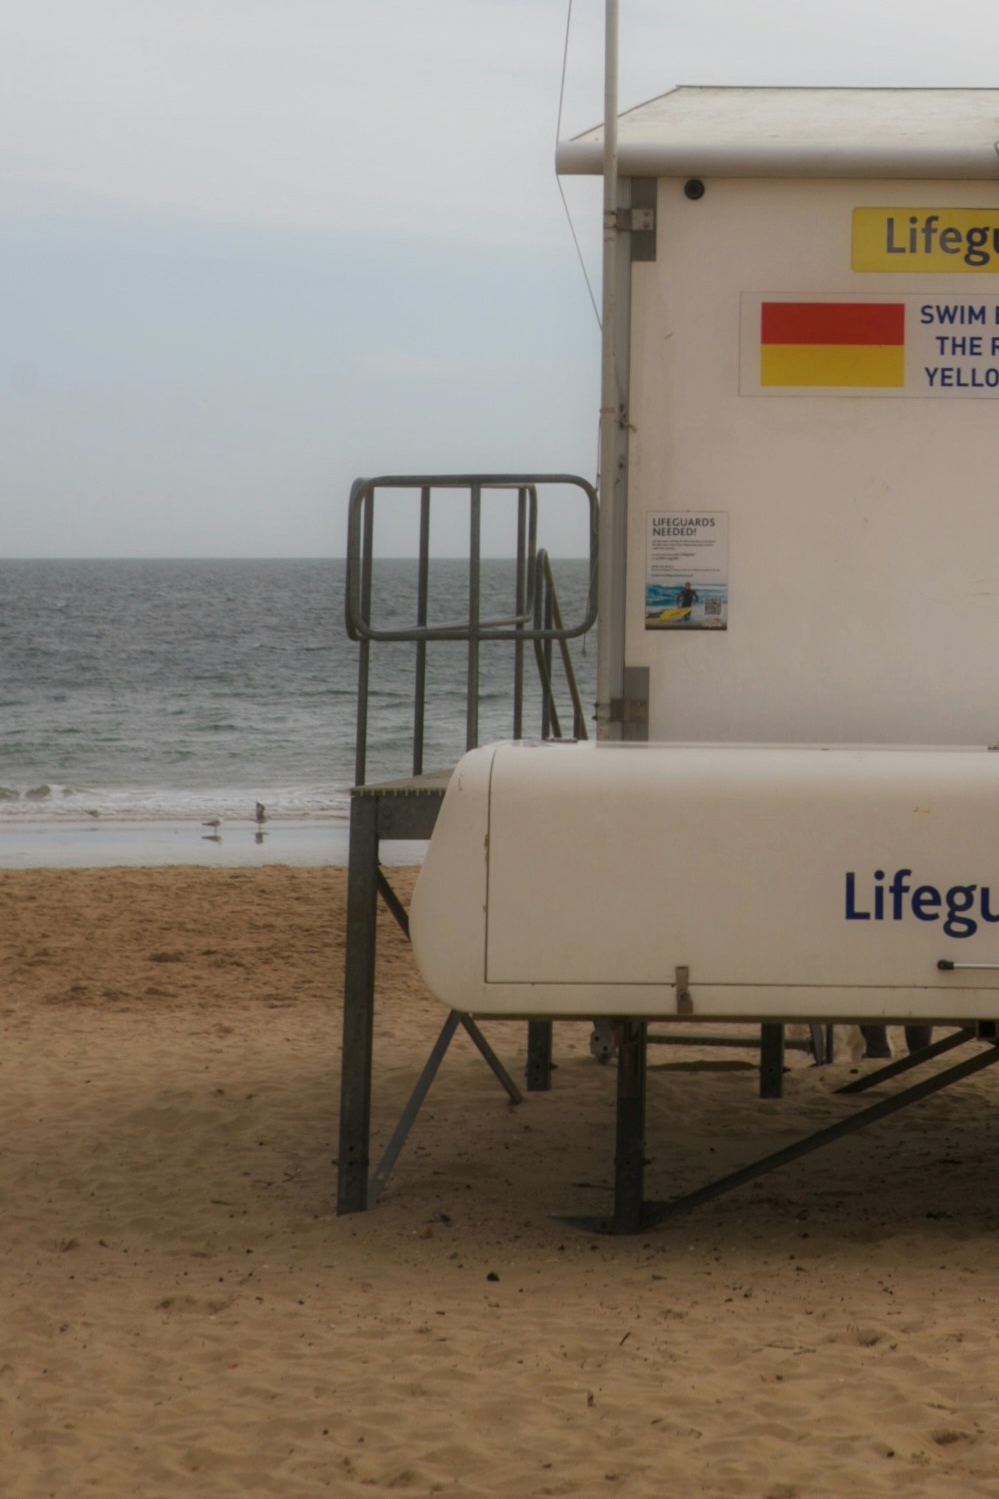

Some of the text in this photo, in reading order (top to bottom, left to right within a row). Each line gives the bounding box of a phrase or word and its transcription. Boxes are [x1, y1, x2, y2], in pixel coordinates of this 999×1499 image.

[920, 305, 986, 325] SWIM
[936, 336, 983, 356] THE
[652, 517, 716, 527] LIFEGUARDS
[652, 527, 696, 536] NEEDED!
